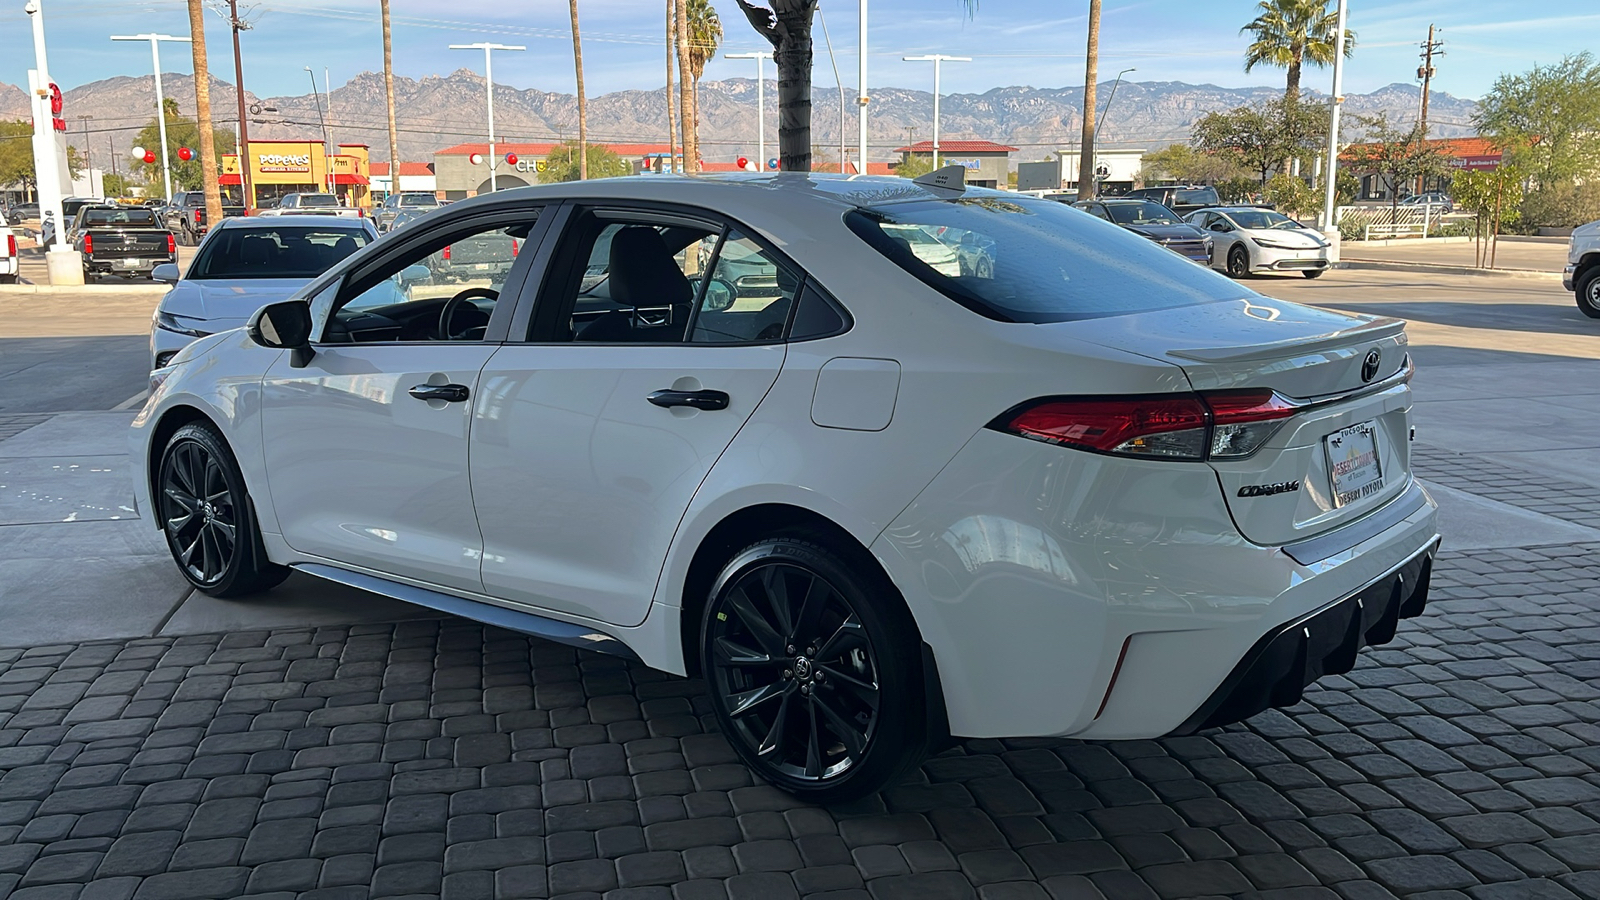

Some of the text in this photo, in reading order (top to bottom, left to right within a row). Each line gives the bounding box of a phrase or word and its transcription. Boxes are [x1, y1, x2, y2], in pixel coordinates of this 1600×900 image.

[1341, 424, 1365, 437] TUCSON
[1333, 458, 1354, 475] DESERT
[1347, 470, 1366, 482] of Tucson
[1339, 479, 1384, 506] DESERT TOYOTA
